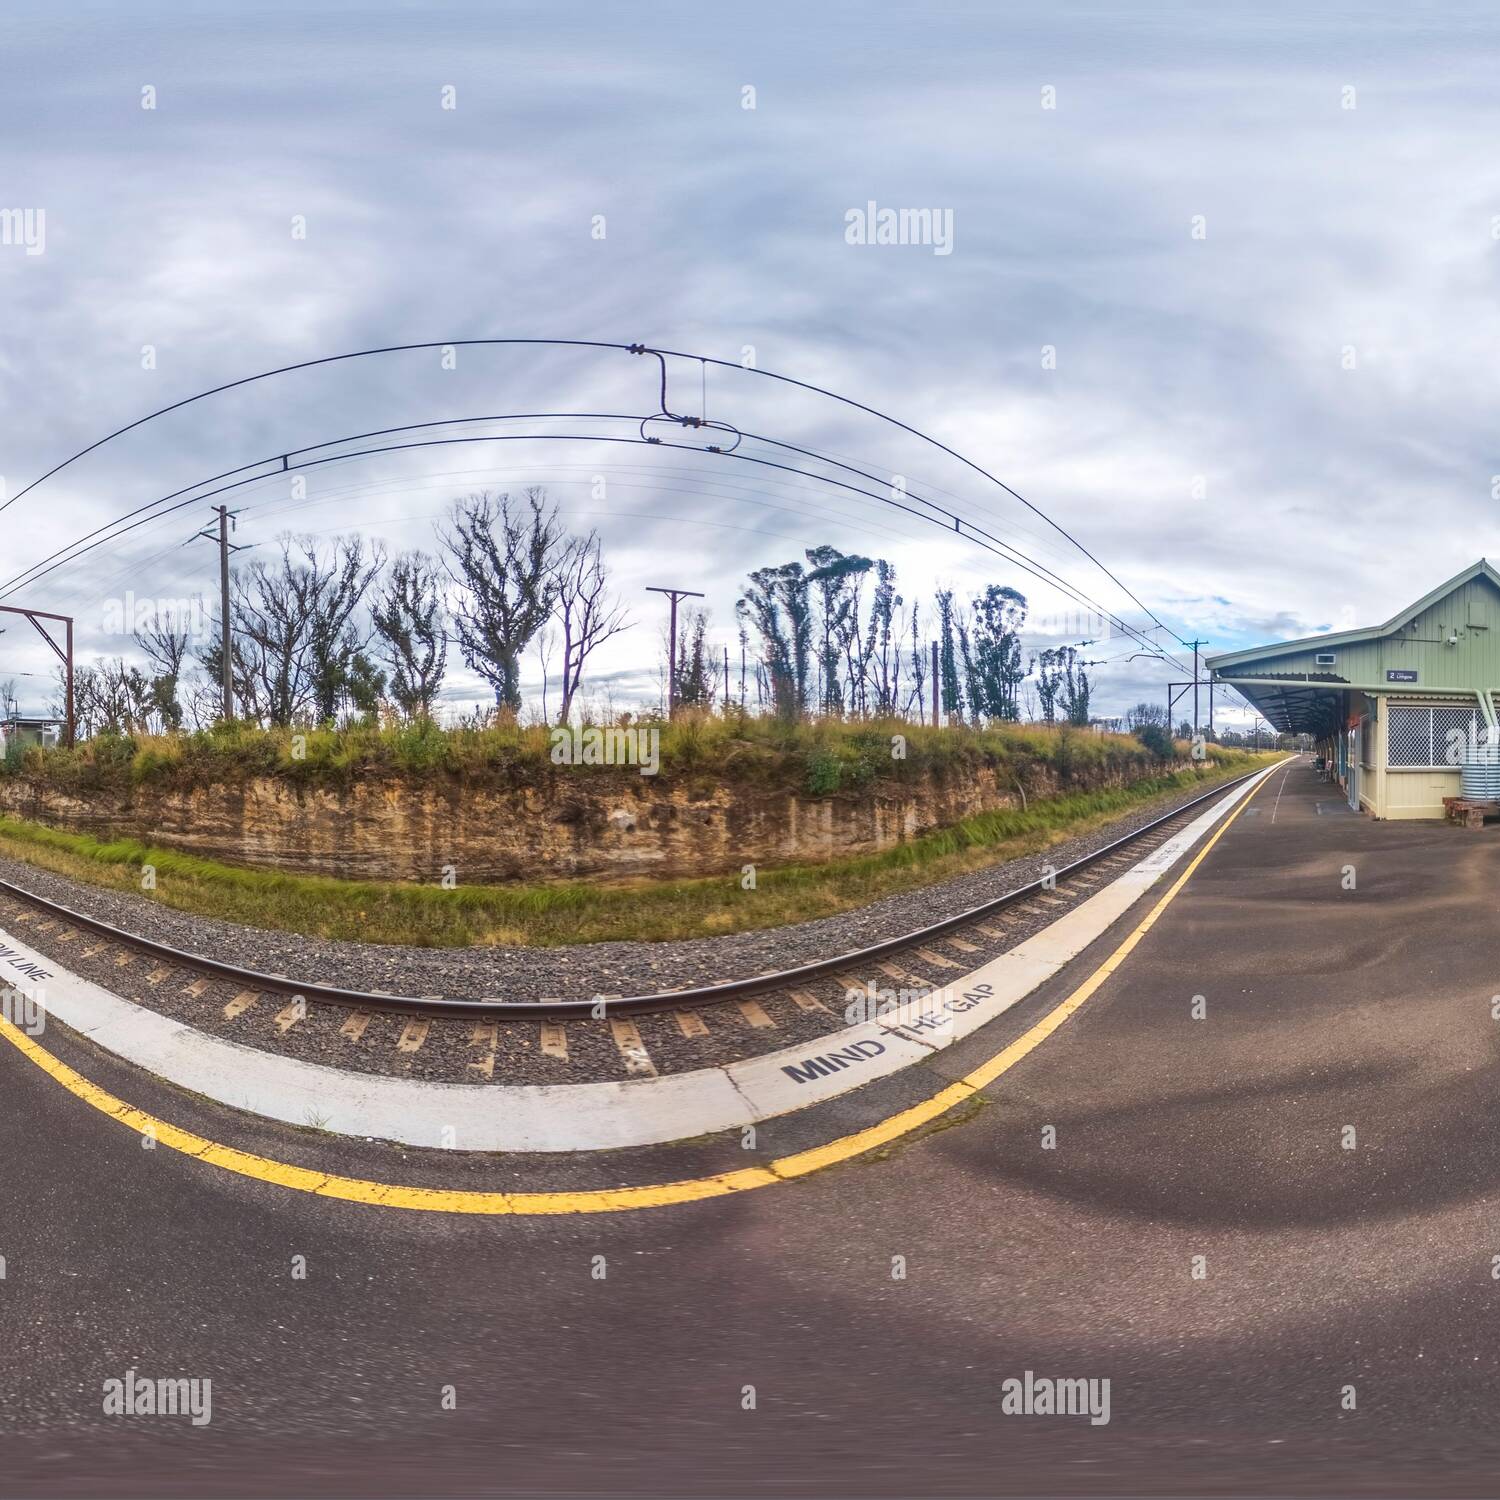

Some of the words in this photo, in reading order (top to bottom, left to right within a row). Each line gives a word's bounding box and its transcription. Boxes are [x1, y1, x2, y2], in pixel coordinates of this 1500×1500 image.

[6, 957, 54, 982] LINE
[780, 1039, 887, 1084] MIND
[879, 1010, 952, 1041] THE
[942, 983, 996, 1013] GAP
